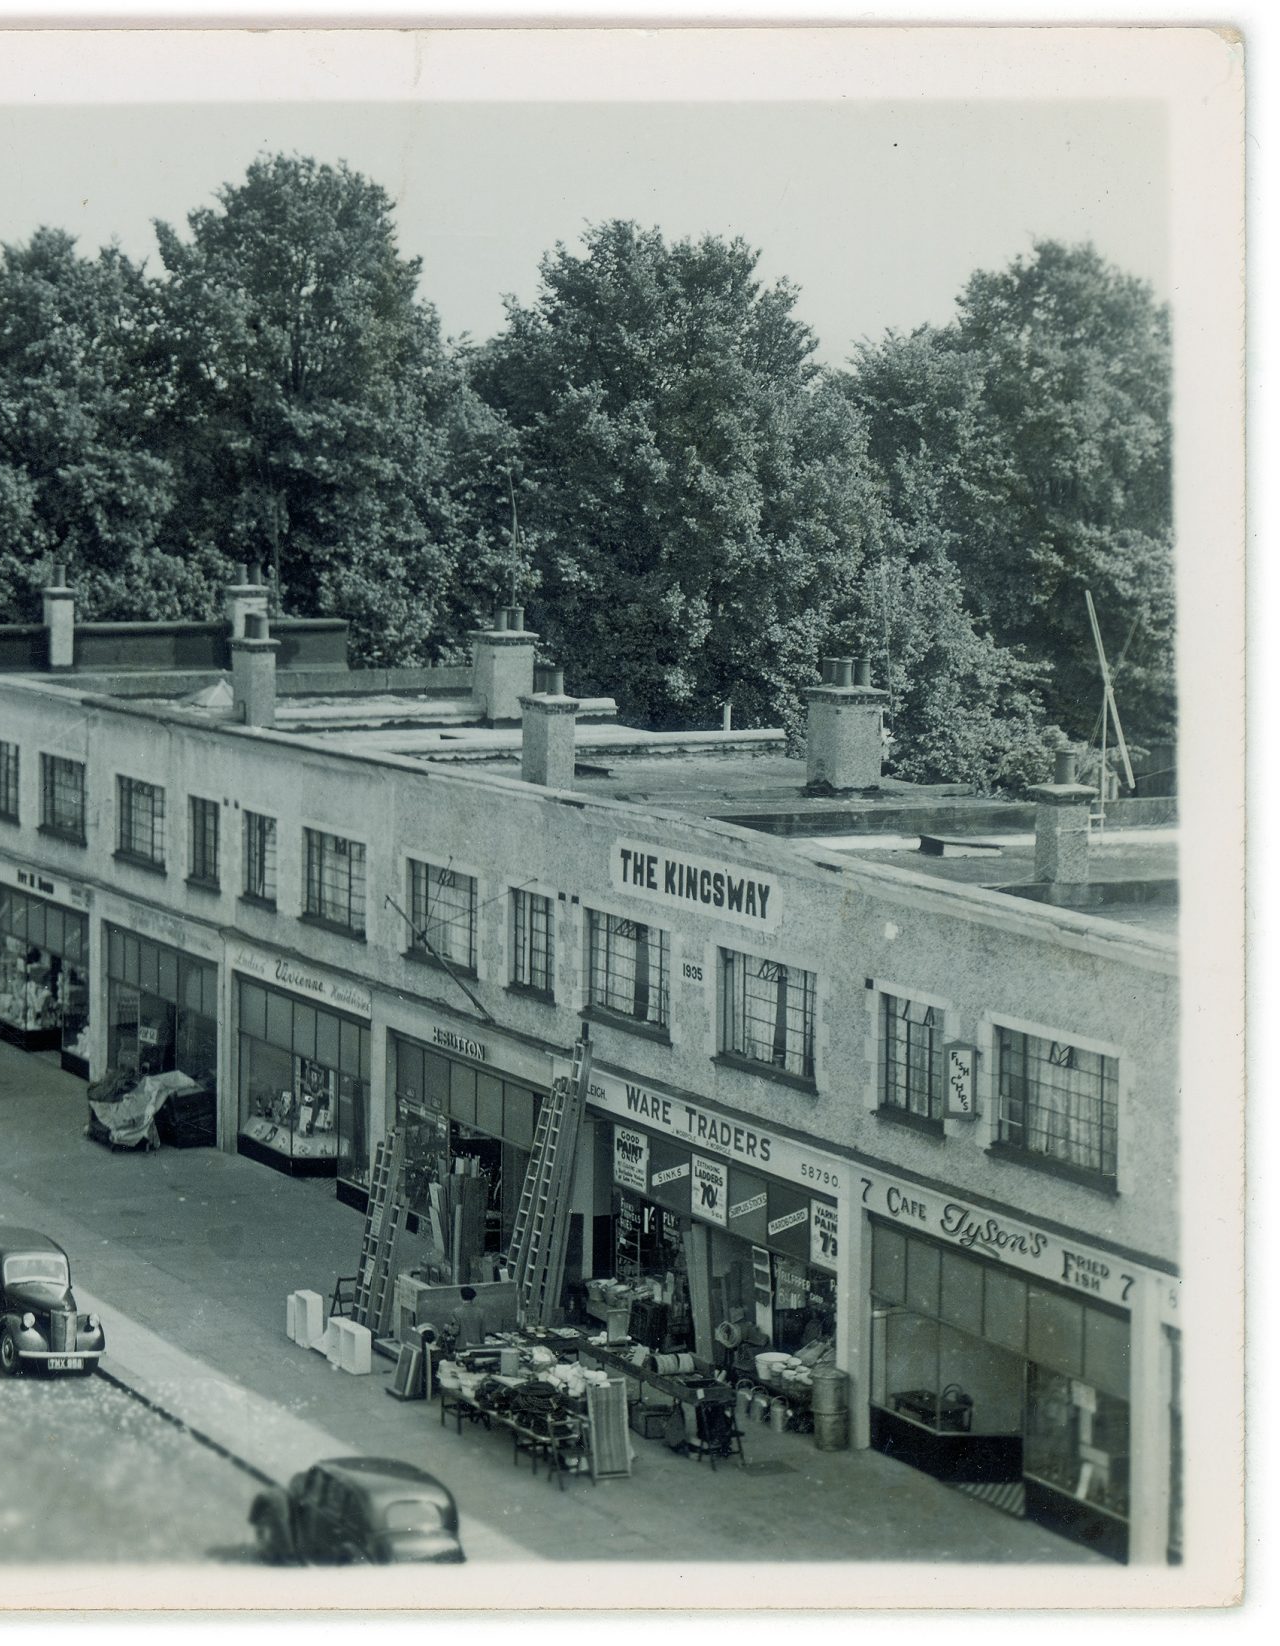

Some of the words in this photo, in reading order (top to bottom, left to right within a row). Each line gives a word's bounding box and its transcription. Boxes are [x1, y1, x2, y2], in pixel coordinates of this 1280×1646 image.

[620, 848, 658, 890] THE
[664, 860, 770, 919] KINGSWAY
[682, 963, 703, 981] 1935
[951, 1052, 969, 1076] FISH
[950, 1076, 969, 1111] CHIPS
[625, 1084, 672, 1125] WARE
[684, 1107, 771, 1161] TRADERS
[621, 1131, 640, 1144] GOOD
[616, 1138, 643, 1159] PAINT
[621, 1153, 639, 1164] ONLY
[696, 1160, 720, 1174] EXTENDING
[657, 1168, 682, 1182] SINKS
[694, 1166, 723, 1187] LADDERS
[730, 1202, 749, 1217] SURPLUS
[816, 1205, 838, 1223] VARNIS
[770, 1211, 806, 1231] HARDBOARD
[814, 1215, 838, 1234] PAIN
[860, 1177, 873, 1203] 7
[886, 1186, 927, 1221] CAFE
[1061, 1250, 1110, 1281] FRIED
[1120, 1274, 1136, 1301] 7
